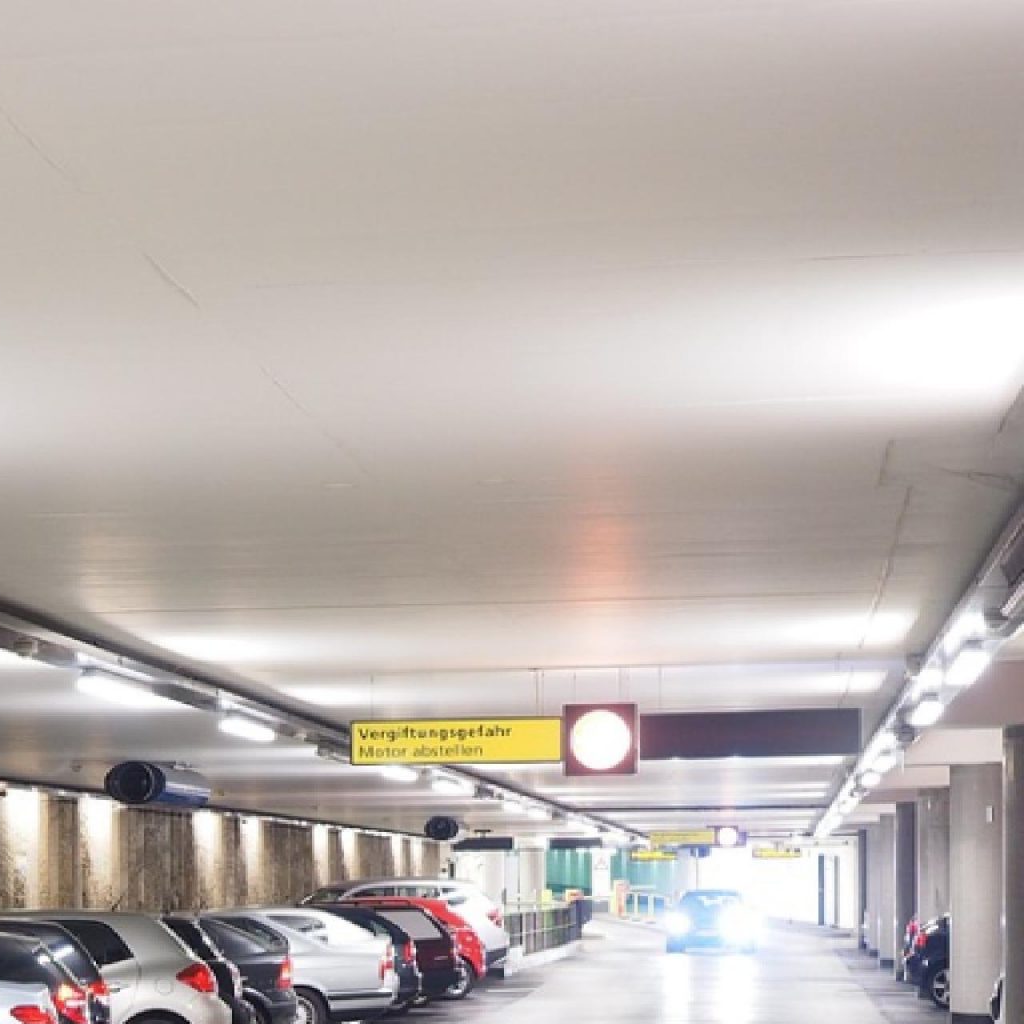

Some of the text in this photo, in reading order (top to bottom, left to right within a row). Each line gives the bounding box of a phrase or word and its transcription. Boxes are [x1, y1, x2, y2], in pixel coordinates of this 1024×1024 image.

[358, 724, 512, 742] Vergiftungsgefahr
[359, 743, 484, 758] Motor abstellen
